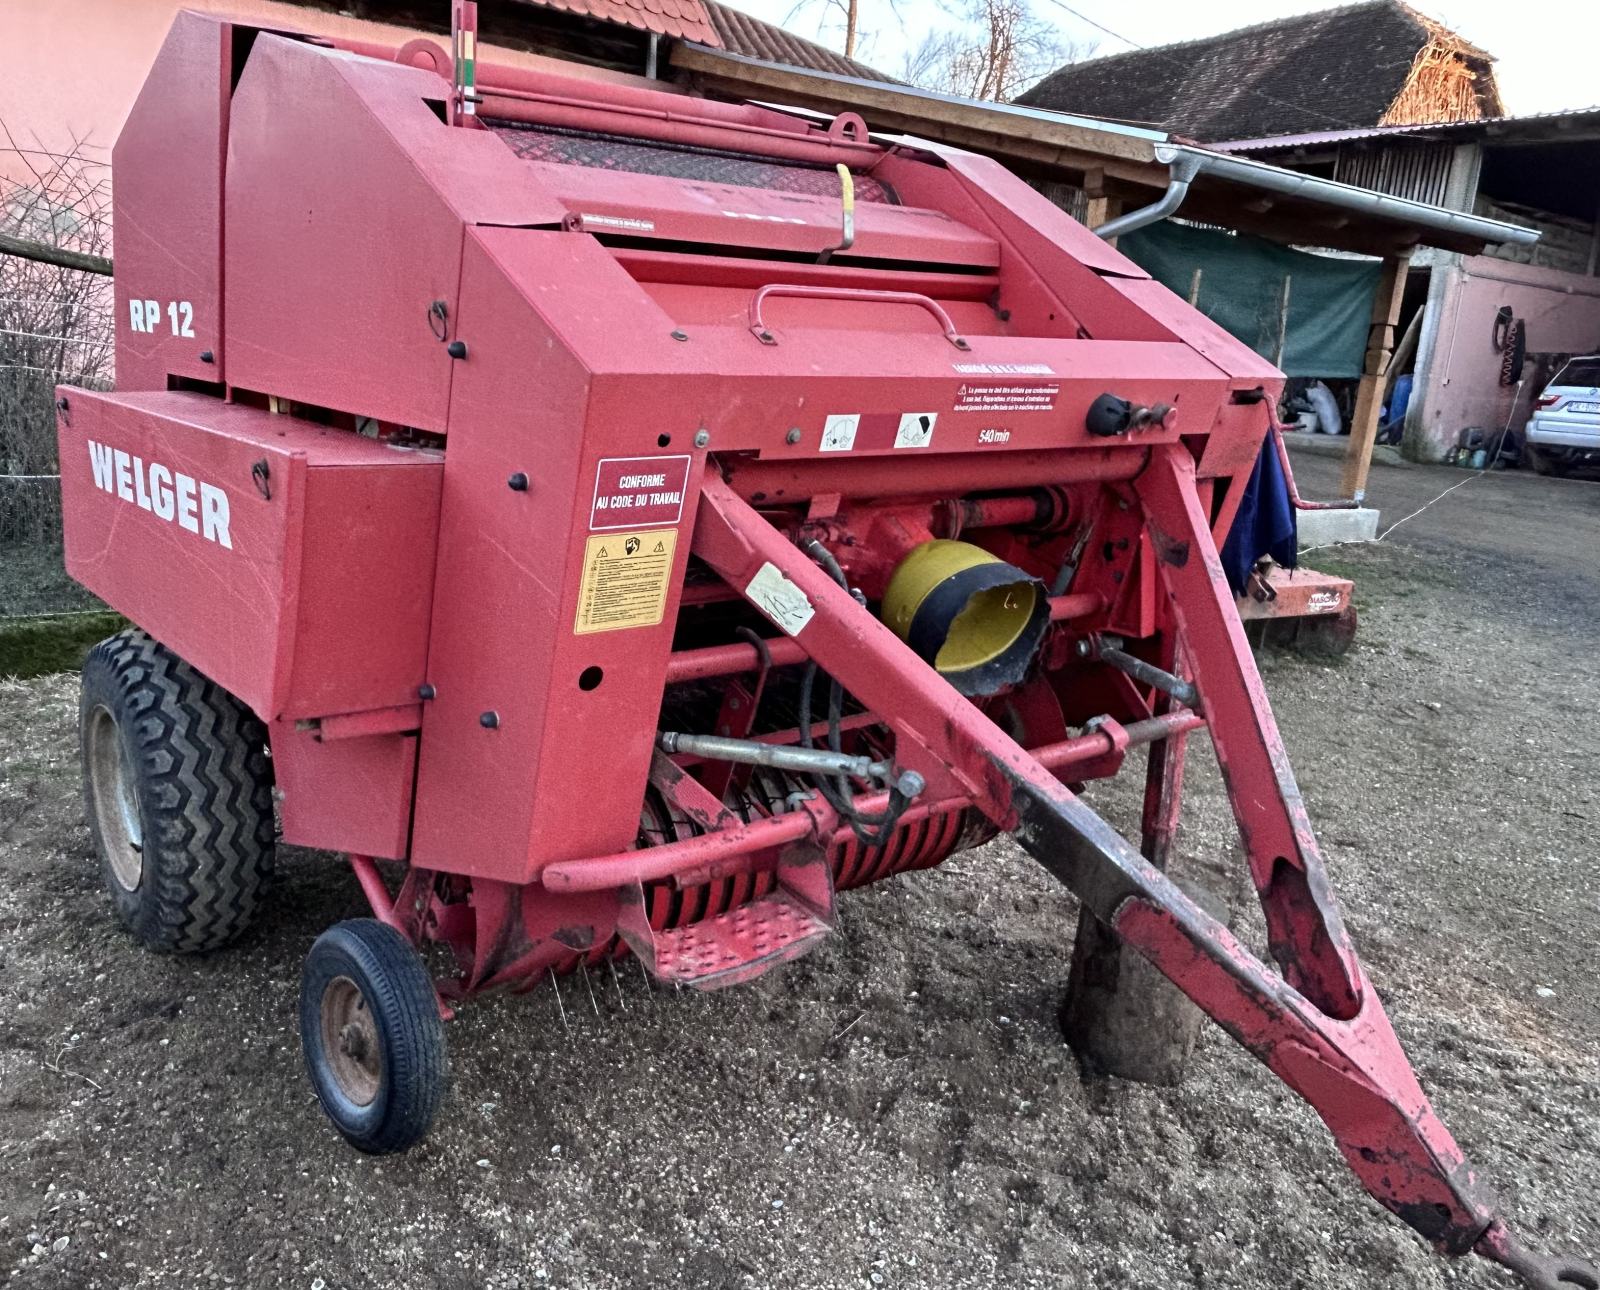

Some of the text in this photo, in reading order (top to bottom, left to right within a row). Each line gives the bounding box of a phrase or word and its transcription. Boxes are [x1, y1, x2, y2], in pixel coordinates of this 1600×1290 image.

[129, 300, 195, 338] RP 12
[88, 439, 233, 550] WELGER
[619, 474, 666, 489] CONFORME
[596, 492, 681, 510] AU CODE DU TRAVAIL
